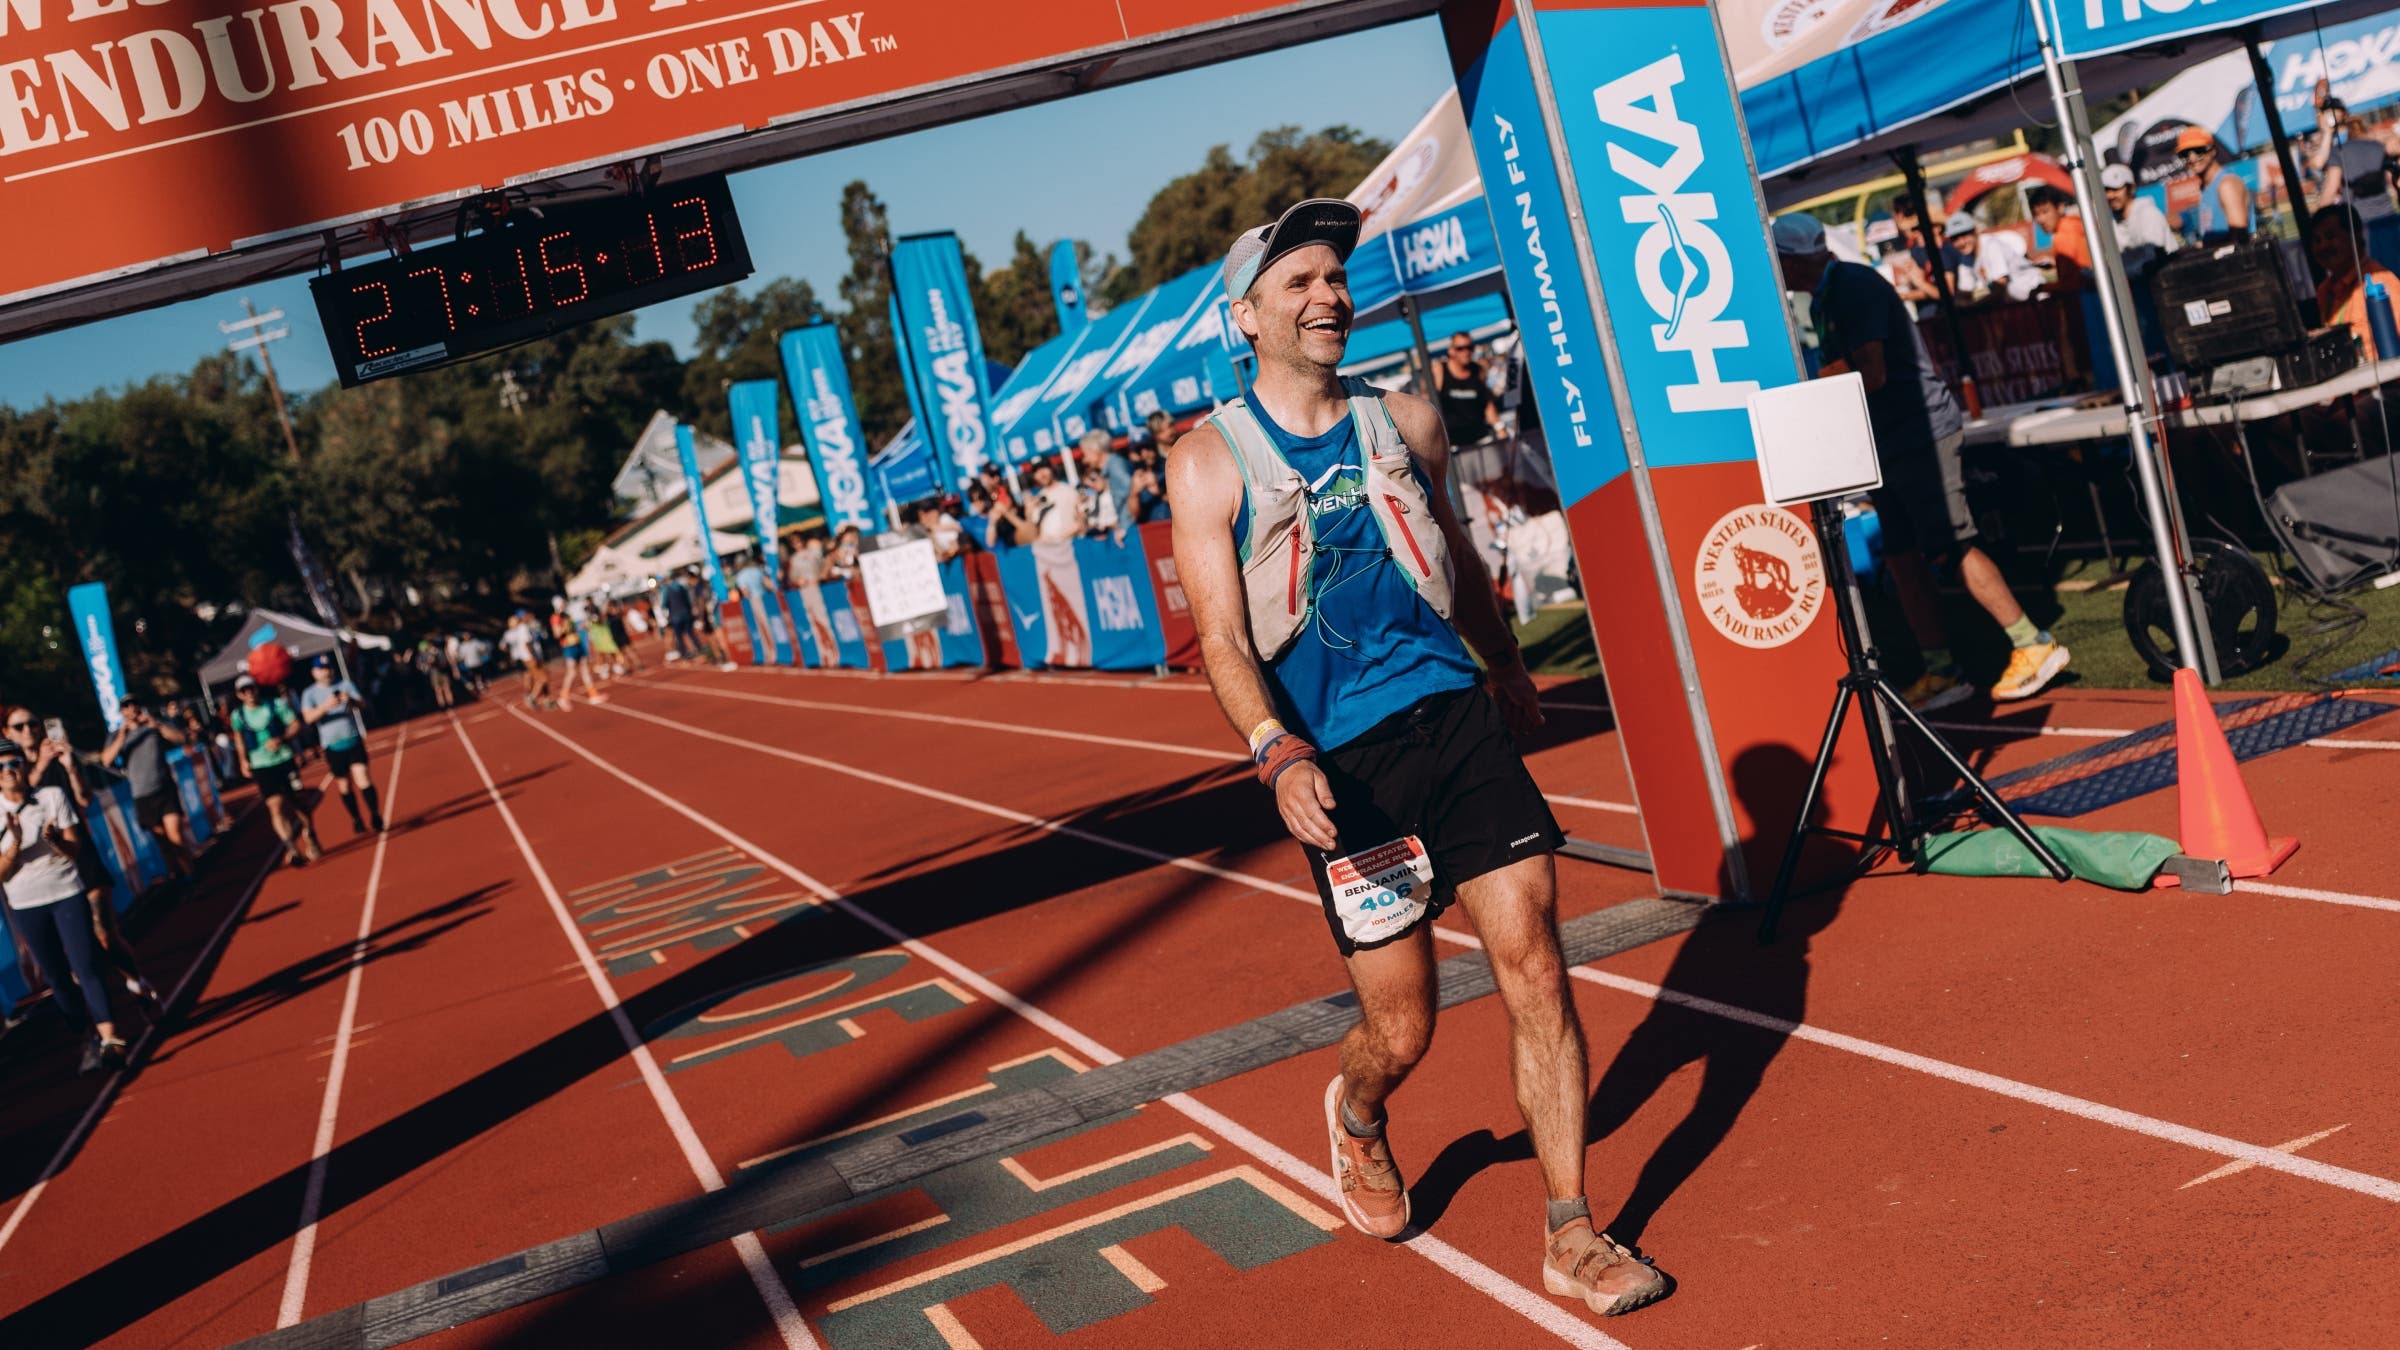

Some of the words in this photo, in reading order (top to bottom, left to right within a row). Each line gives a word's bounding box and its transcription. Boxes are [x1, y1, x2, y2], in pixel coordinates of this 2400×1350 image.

[336, 108, 435, 171] 100
[439, 67, 615, 148] MILES
[646, 36, 759, 99] ONE
[763, 11, 868, 75] DAY
[1494, 114, 1526, 186] FLY
[1403, 215, 1470, 279] HOKA
[1592, 52, 1762, 413] HOKA
[1515, 191, 1573, 367] HUMAN
[1562, 376, 1593, 448] FLY
[814, 416, 875, 534] HOKA
[1702, 512, 1757, 572] WESTERN
[1759, 511, 1810, 549] STATES
[1712, 604, 1803, 641] ENDURANCE
[1799, 577, 1820, 613] RUN
[1336, 856, 1376, 873] WESTERN
[1377, 843, 1408, 859] STATES
[1340, 859, 1391, 880] ENDURANCE
[1391, 851, 1411, 862] RUN
[1344, 864, 1418, 897] BENJAMIN
[1359, 882, 1413, 911] 406
[1371, 918, 1386, 927] 100
[1387, 902, 1414, 921] MILES
